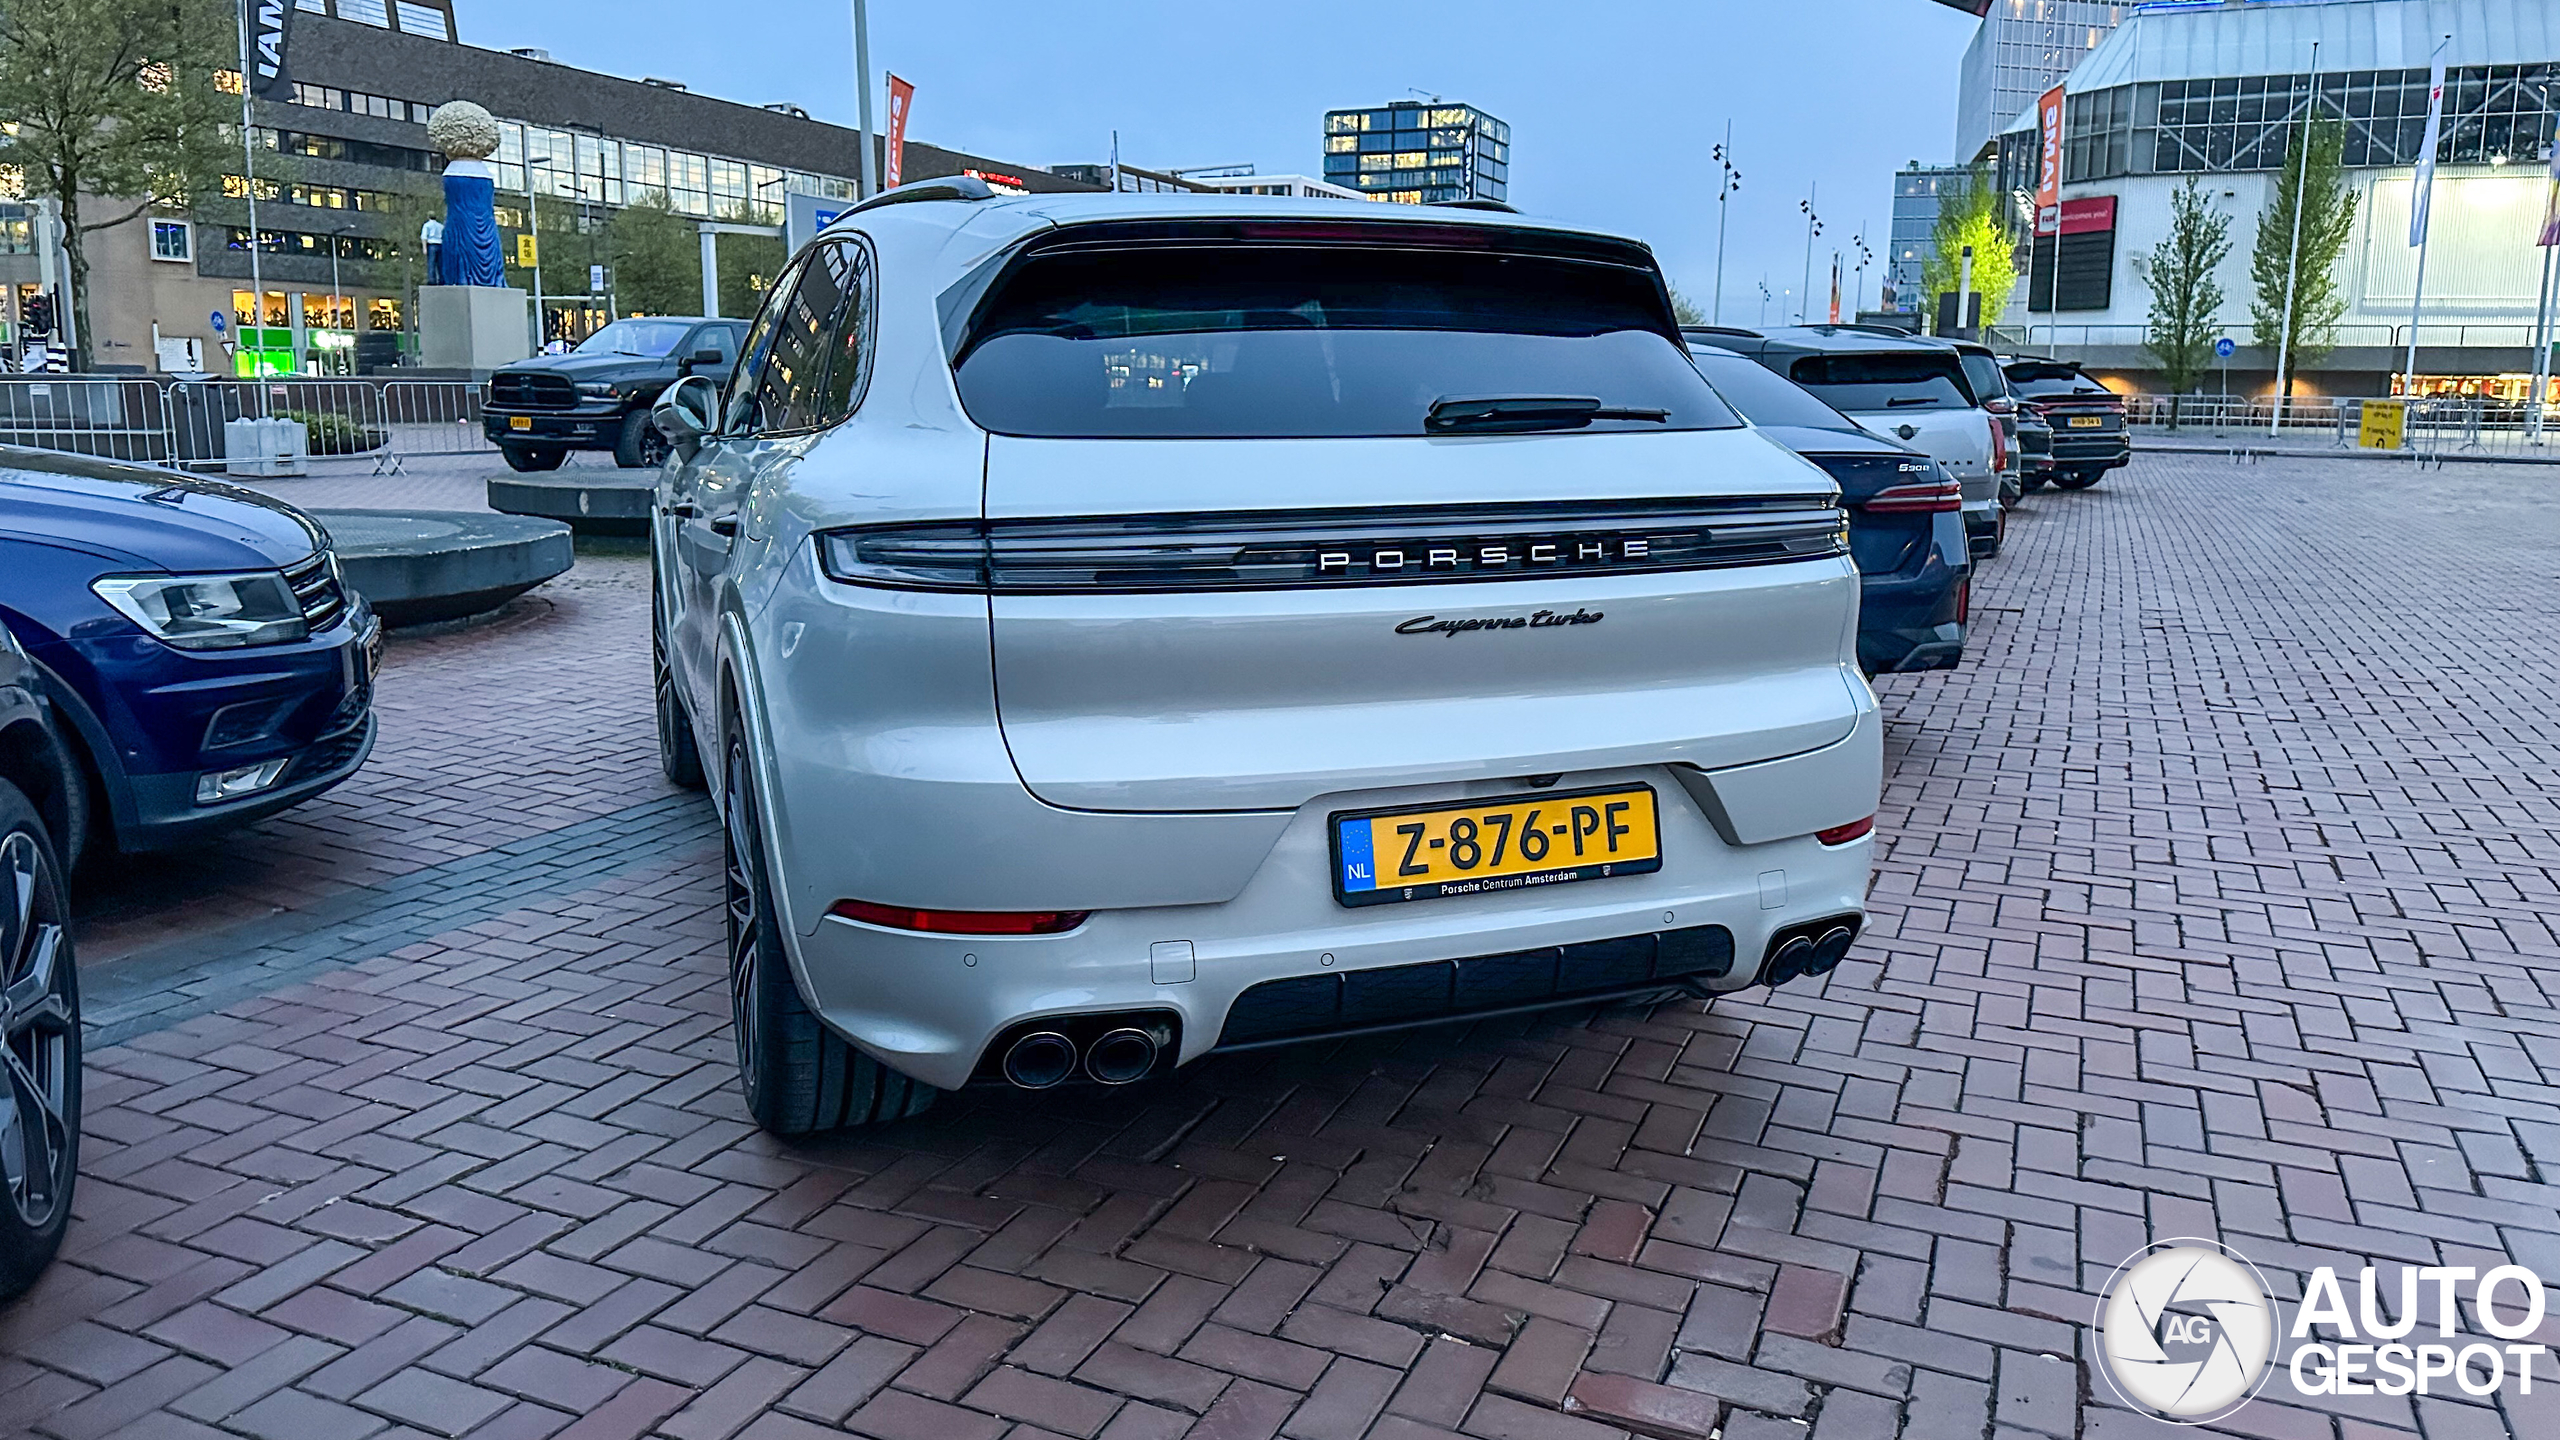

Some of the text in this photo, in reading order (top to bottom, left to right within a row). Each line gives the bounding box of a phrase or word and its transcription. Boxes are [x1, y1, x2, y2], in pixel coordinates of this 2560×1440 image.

[1320, 540, 1649, 571] PORSCHE
[1395, 608, 1605, 638] Cayenne turbo
[1396, 801, 1631, 877] Z-876-PF
[1347, 862, 1371, 880] NL
[1441, 870, 1578, 896] Porsche Centrum Amsterdam
